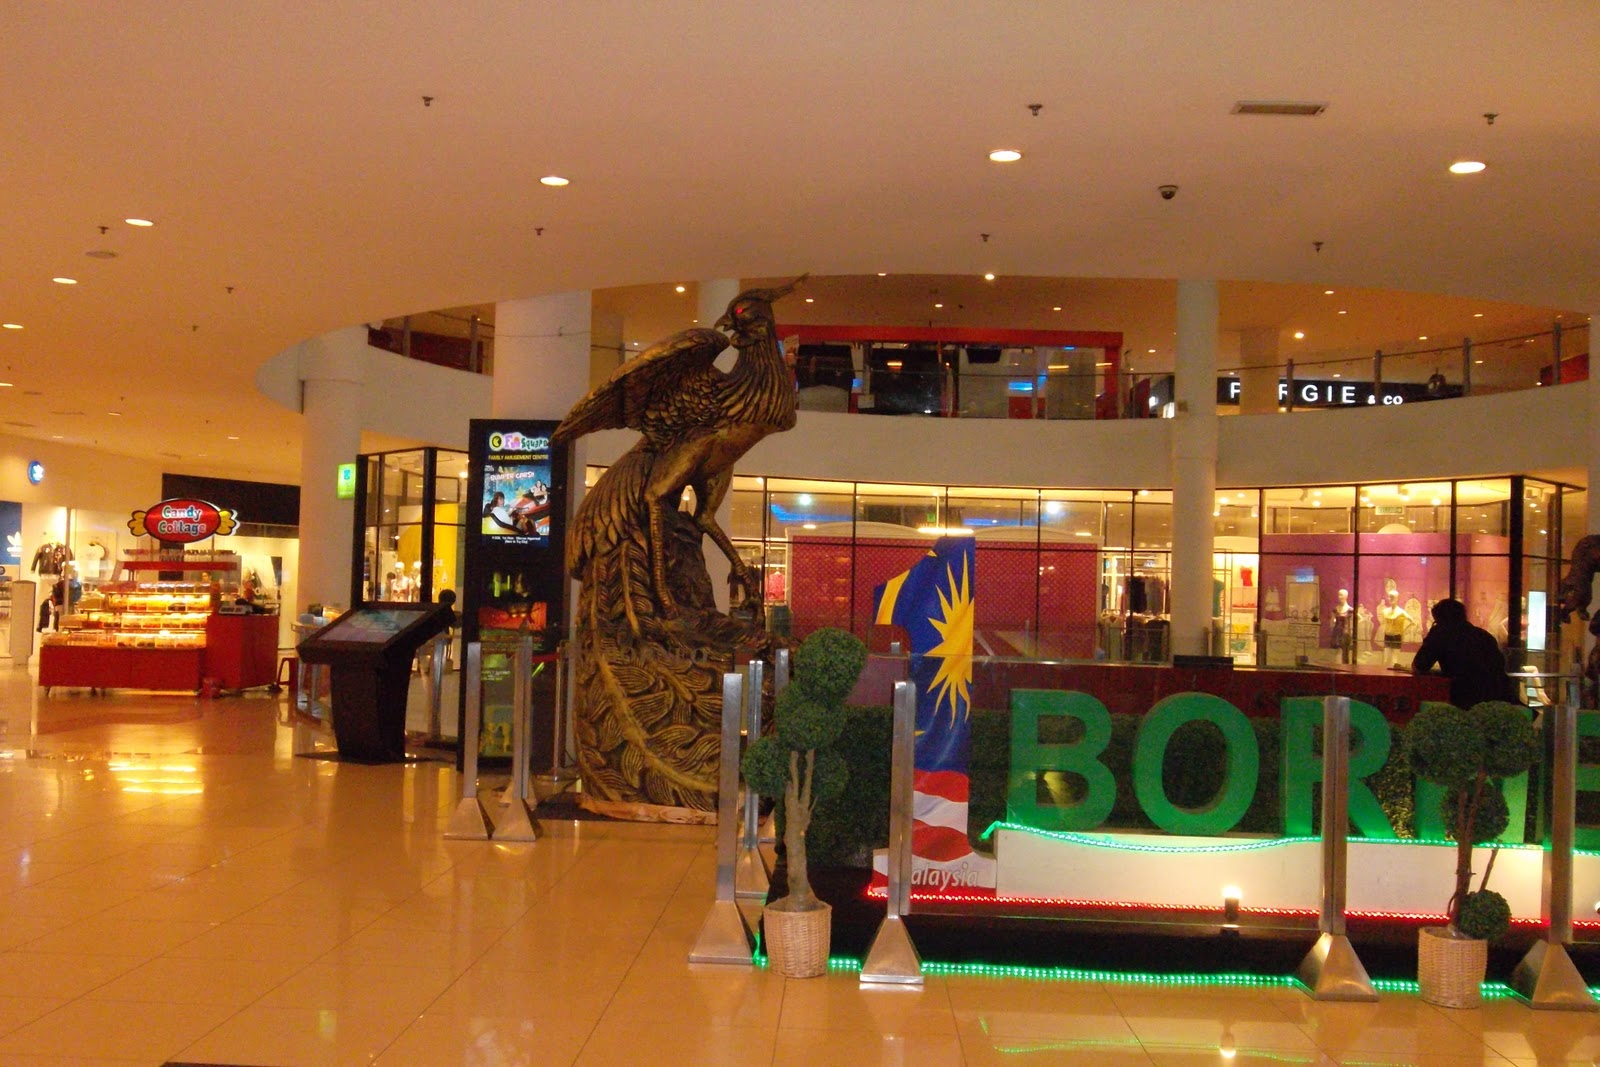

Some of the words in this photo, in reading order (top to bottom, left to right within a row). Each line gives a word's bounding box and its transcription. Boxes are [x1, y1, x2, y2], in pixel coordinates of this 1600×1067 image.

[162, 505, 201, 520] Candy
[159, 520, 206, 535] Cottage
[910, 862, 980, 892] alaysia
